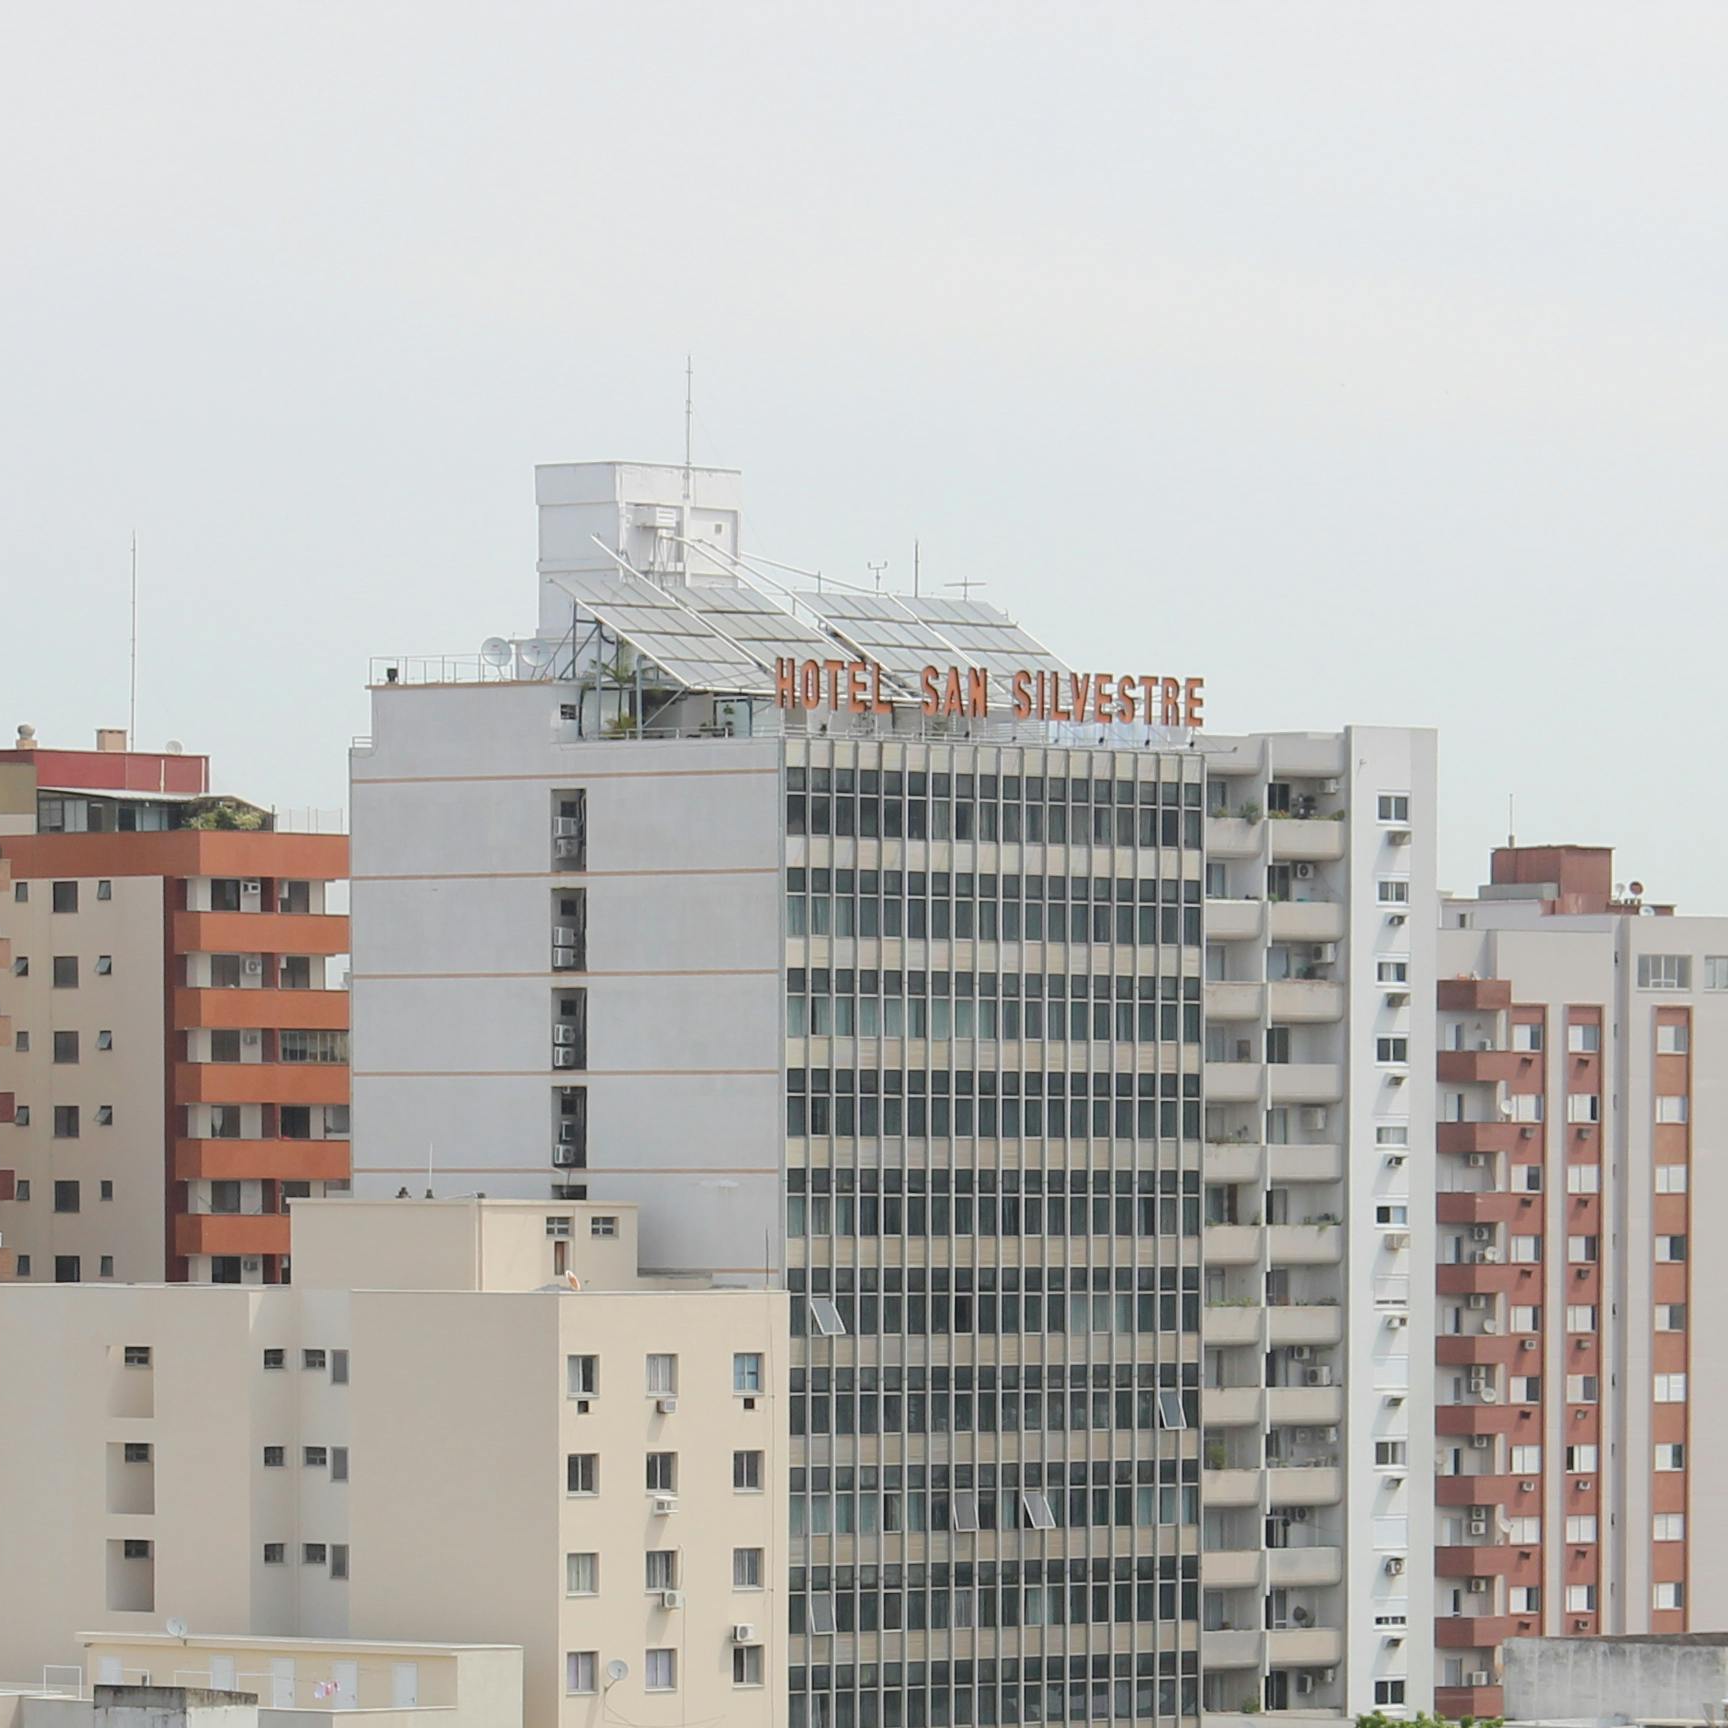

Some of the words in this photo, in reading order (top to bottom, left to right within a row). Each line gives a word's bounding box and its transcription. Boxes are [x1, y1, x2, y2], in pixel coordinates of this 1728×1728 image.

[774, 656, 893, 715] HOTEL
[920, 665, 988, 719] SAN
[1013, 670, 1206, 728] SILVESTRE
